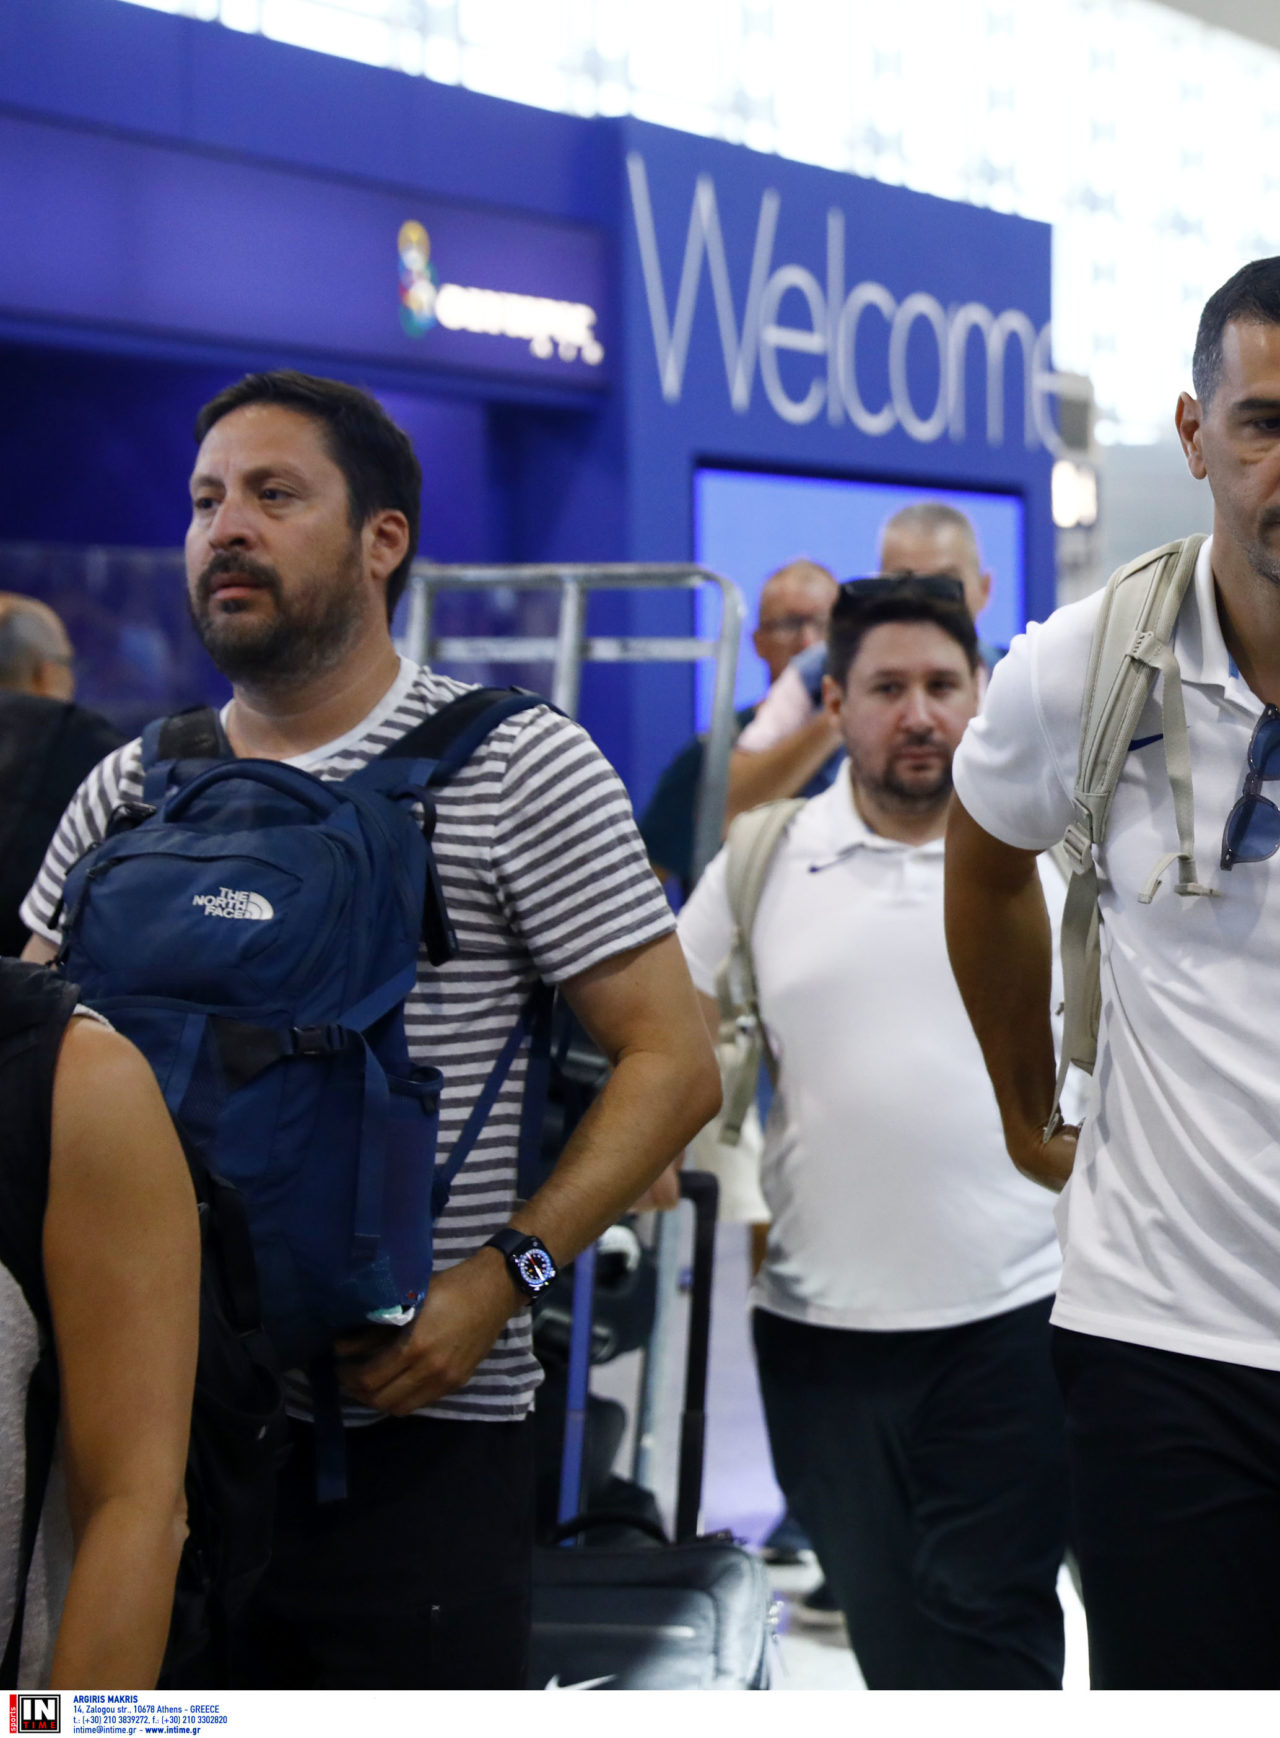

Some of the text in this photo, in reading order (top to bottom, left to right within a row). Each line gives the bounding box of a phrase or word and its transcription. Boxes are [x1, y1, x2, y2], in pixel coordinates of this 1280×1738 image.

[219, 887, 249, 901] THE
[192, 895, 247, 911] NORTH
[204, 904, 249, 919] FACE
